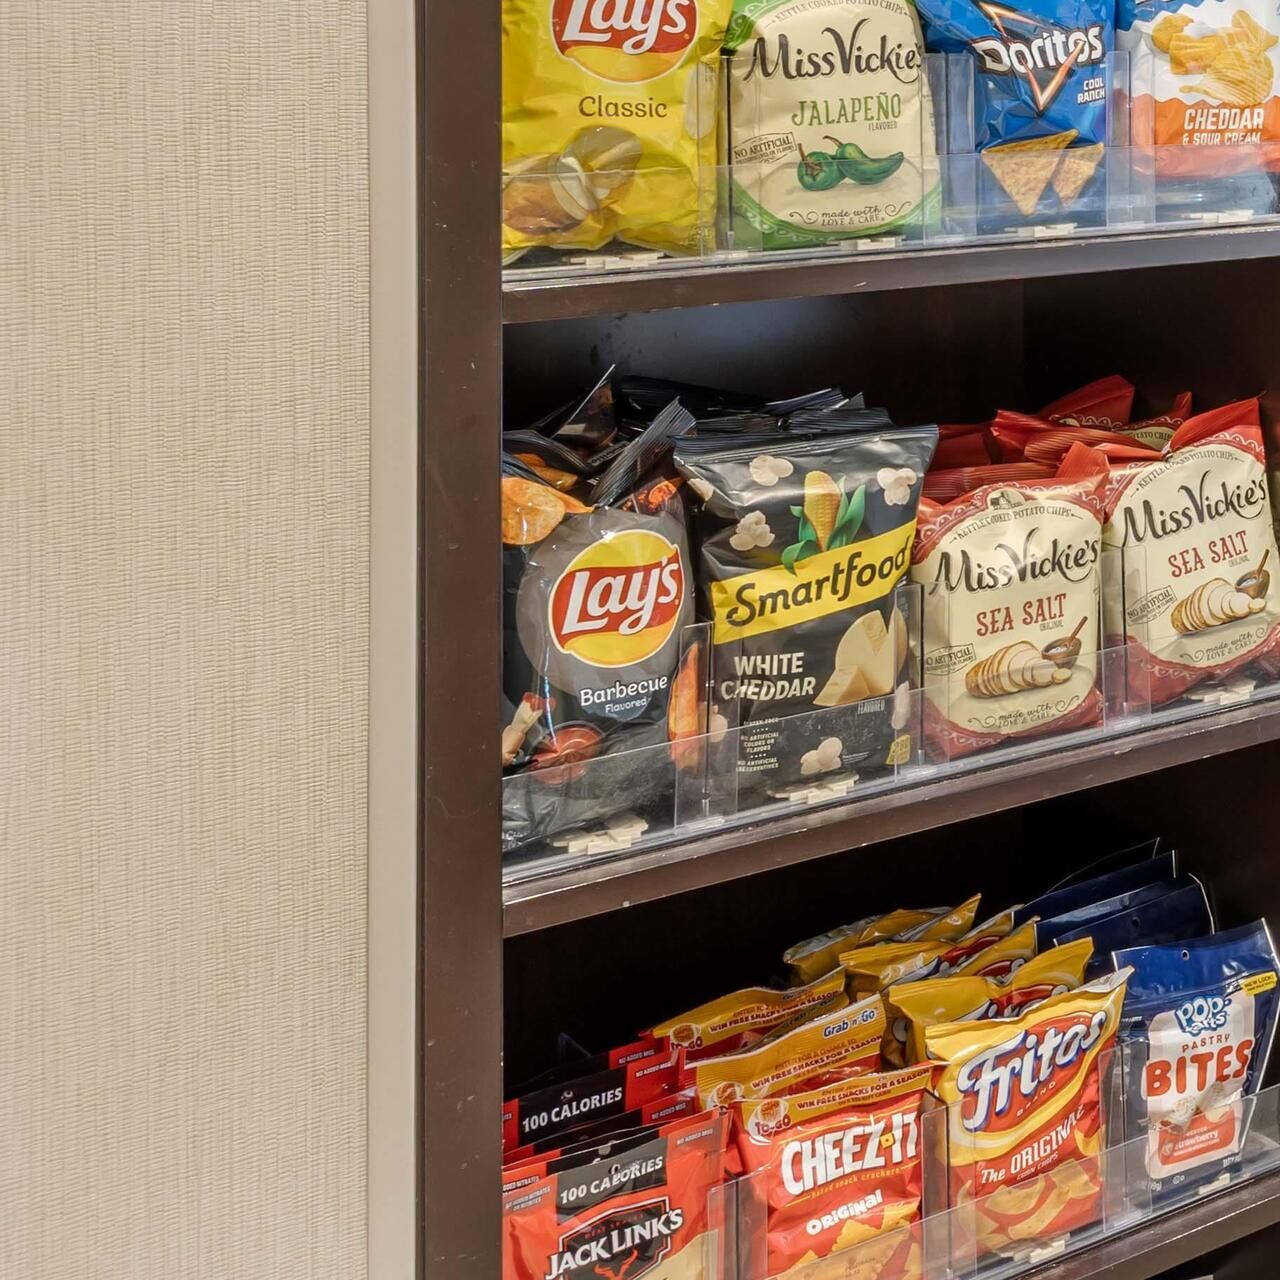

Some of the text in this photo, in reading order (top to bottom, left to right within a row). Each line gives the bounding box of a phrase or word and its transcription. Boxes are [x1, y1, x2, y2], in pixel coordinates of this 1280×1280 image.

[776, 3, 807, 23] KETTLE
[880, 0, 905, 15] CHIPS
[973, 26, 1104, 72] Doritos
[1078, 88, 1105, 103] RANCH
[1084, 79, 1104, 90] COOL
[579, 96, 667, 118] Classic
[792, 92, 901, 126] JALAPEÑO
[1184, 108, 1264, 130] CHEDDAR
[868, 121, 897, 132] FLAVORED
[1193, 132, 1260, 145] SOUR CREAM
[734, 147, 748, 159] NO
[750, 136, 793, 154] ARTIFICIAL
[822, 206, 881, 218] made with
[822, 217, 845, 226] LOVE
[1138, 450, 1235, 489] KETTLE POTATO CHIPS
[957, 506, 1071, 539] KETTLE POTATO CHIPS
[1168, 531, 1248, 578] SEA SALT
[561, 557, 680, 636] Lay's
[726, 545, 911, 628] Smartfood
[976, 593, 1067, 637] SEA SALT
[1206, 634, 1253, 652] made with
[735, 652, 804, 676] WHITE
[580, 676, 668, 707] Barbecue
[721, 677, 816, 701] CHEDDAR
[605, 698, 647, 713] Flavored
[998, 705, 1053, 719] made with
[709, 990, 840, 1033] WIN FREE SEASON
[823, 1009, 876, 1038] Grab Go
[1182, 1034, 1230, 1053] PASTRY
[752, 1078, 769, 1089] WIN
[771, 1069, 792, 1083] FREE
[794, 1057, 825, 1074] SNACKS
[826, 1051, 843, 1062] FOR
[851, 1034, 883, 1052] SEASON
[958, 1011, 1106, 1130] Fritos
[1146, 1039, 1253, 1097] BITES
[797, 1100, 815, 1110] WIN
[816, 1095, 838, 1106] FREE
[839, 1087, 869, 1101] SNACKS
[870, 1082, 887, 1093] FOR
[896, 1070, 930, 1085] SEASON
[523, 1087, 623, 1133] 100 CALORIES
[754, 1115, 791, 1137] TO-GO
[981, 1103, 1085, 1184] The ORIGINAL
[560, 1156, 663, 1204] 100 CALORIES
[811, 1167, 900, 1200] baked snack crackers
[544, 1208, 683, 1280] JACK LINK'S
